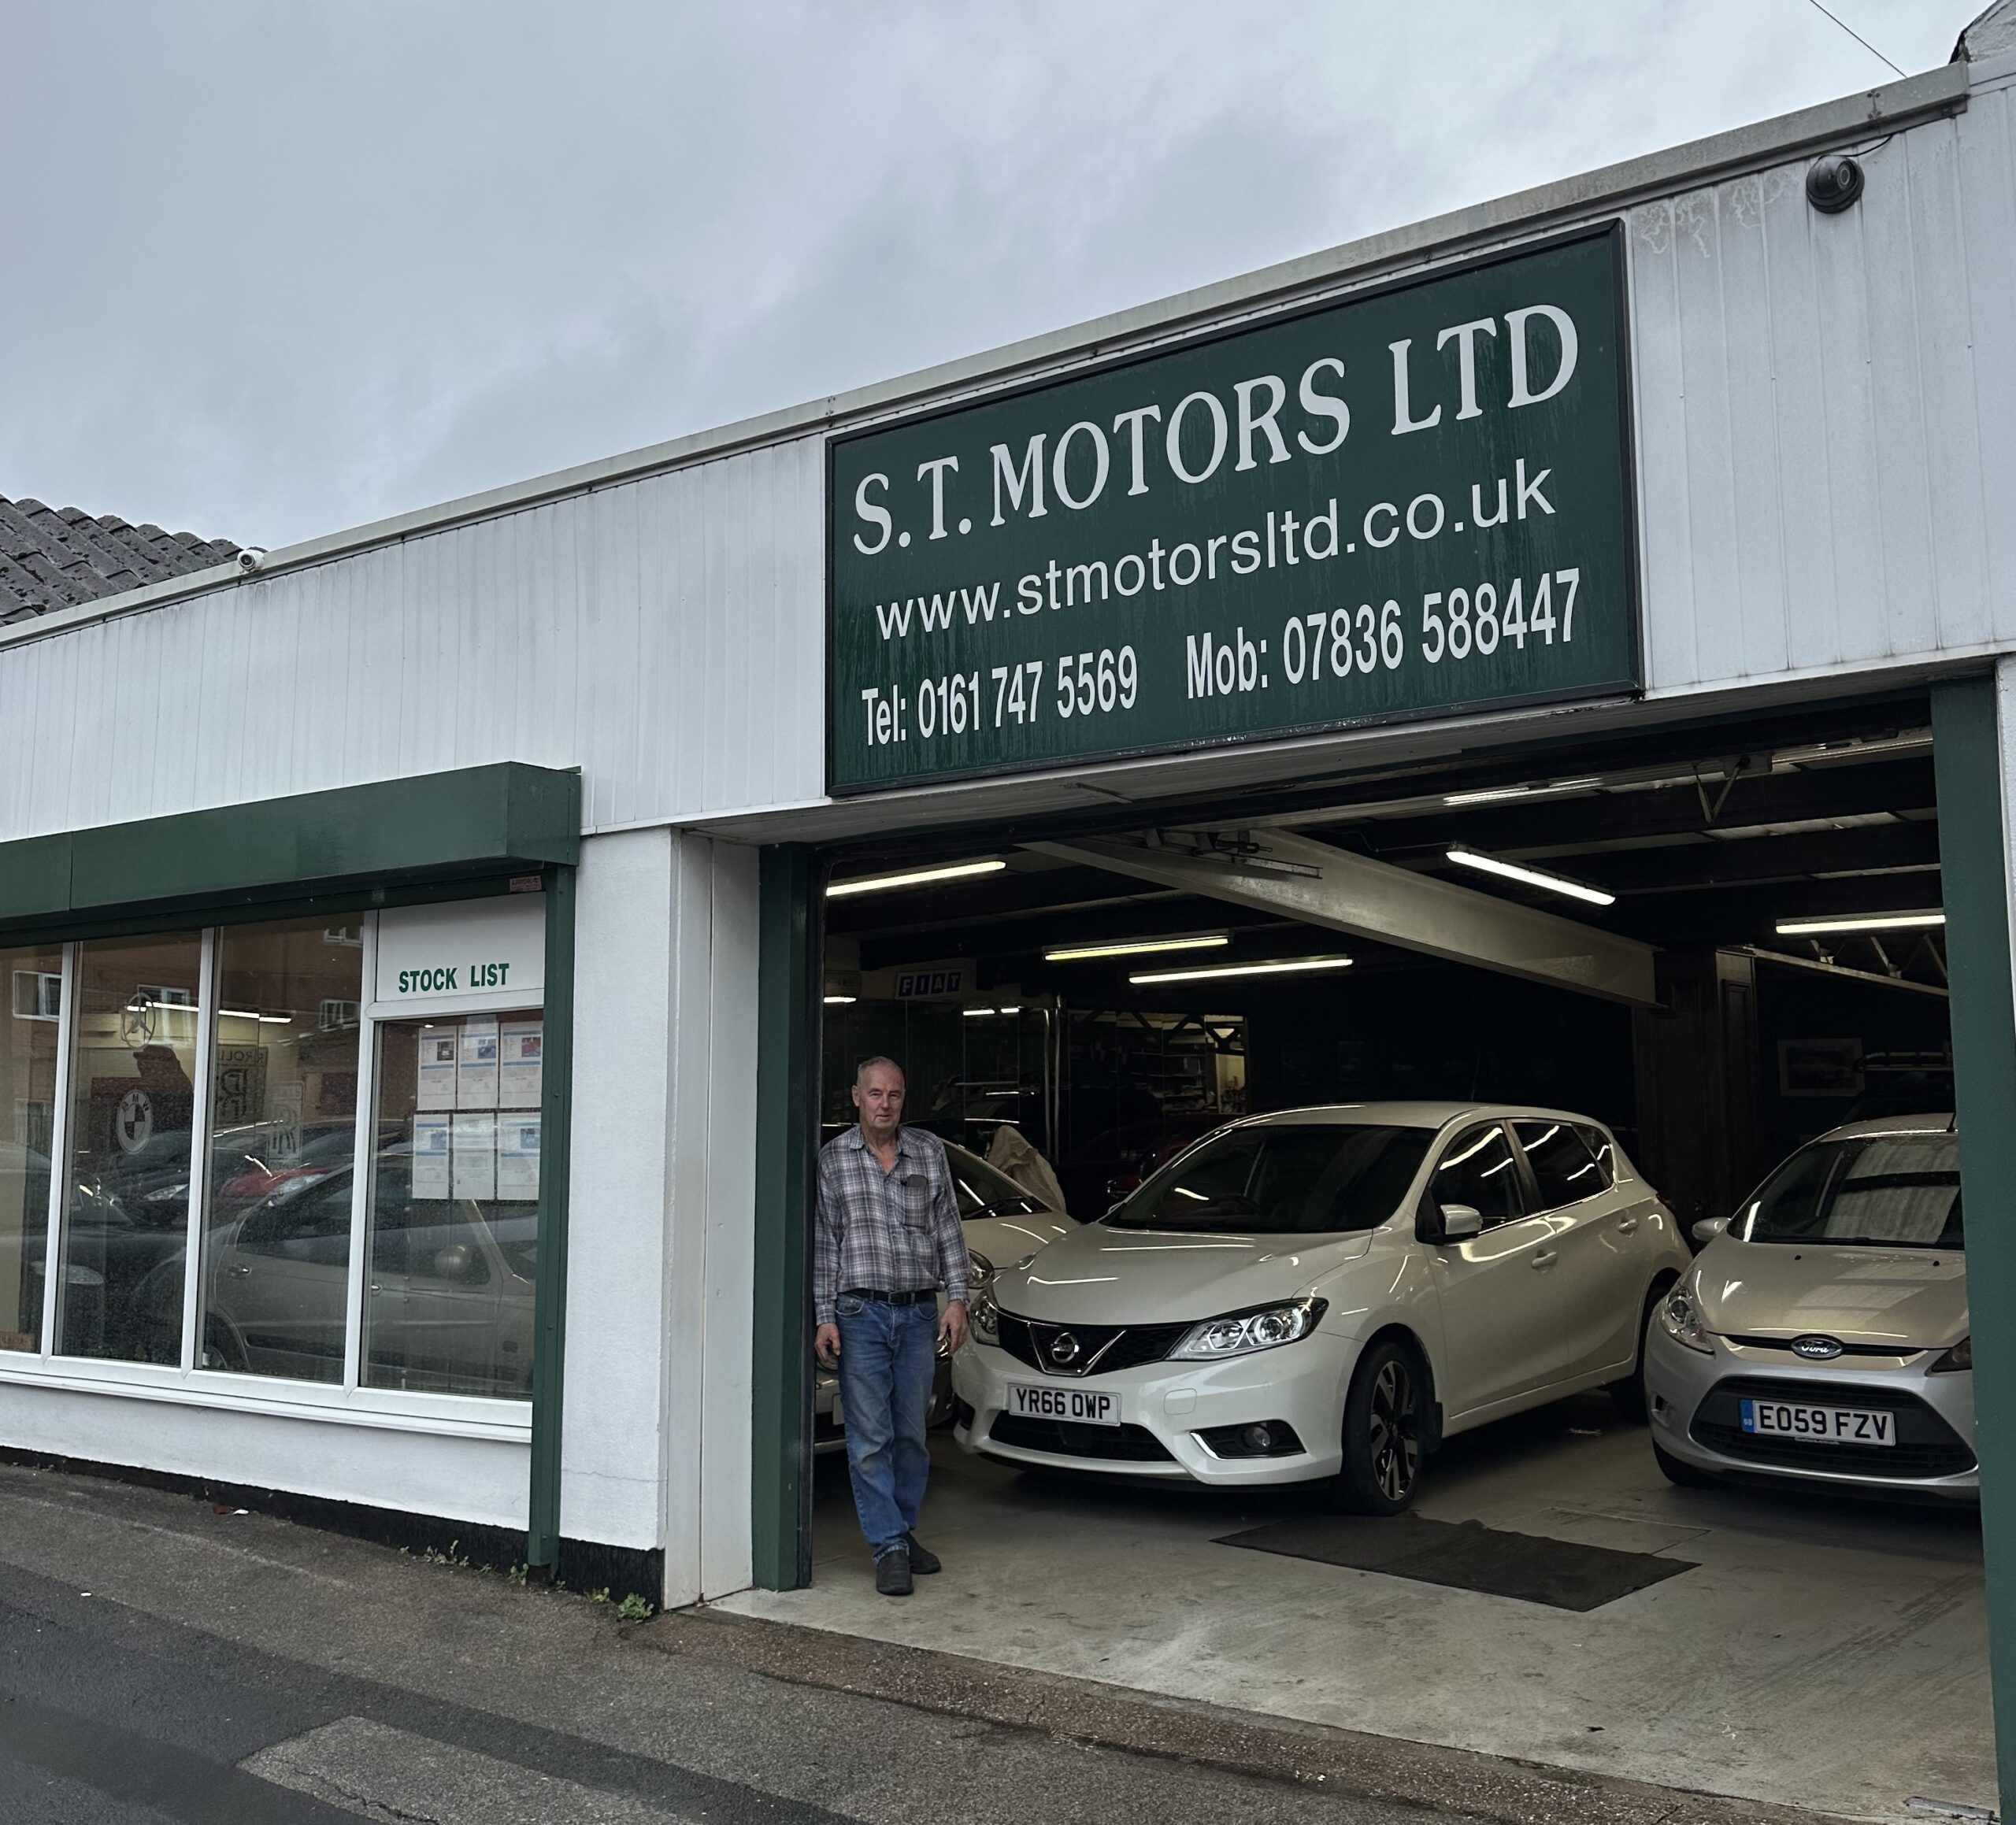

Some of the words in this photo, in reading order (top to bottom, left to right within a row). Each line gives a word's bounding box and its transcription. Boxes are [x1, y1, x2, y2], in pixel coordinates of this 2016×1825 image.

[853, 455, 972, 555] S.T.
[989, 357, 1351, 527] MOTORS
[1388, 304, 1578, 435] LTD
[876, 457, 1556, 640] www.stmotorsltd.co.uk
[862, 684, 906, 746] Tel:
[917, 671, 980, 739] 0161
[991, 661, 1043, 727] 747
[1057, 645, 1137, 719] 5569
[1186, 626, 1268, 699] Mob:
[1283, 599, 1404, 685] 07836
[1421, 567, 1580, 664] 588447
[398, 968, 458, 993] STOCK
[470, 963, 510, 987] LIST
[901, 975, 959, 994] FIAT
[1016, 1388, 1065, 1415] YR66
[1072, 1394, 1110, 1420] OWP
[1758, 1405, 1827, 1434] EO59
[1835, 1412, 1888, 1440] FZV
